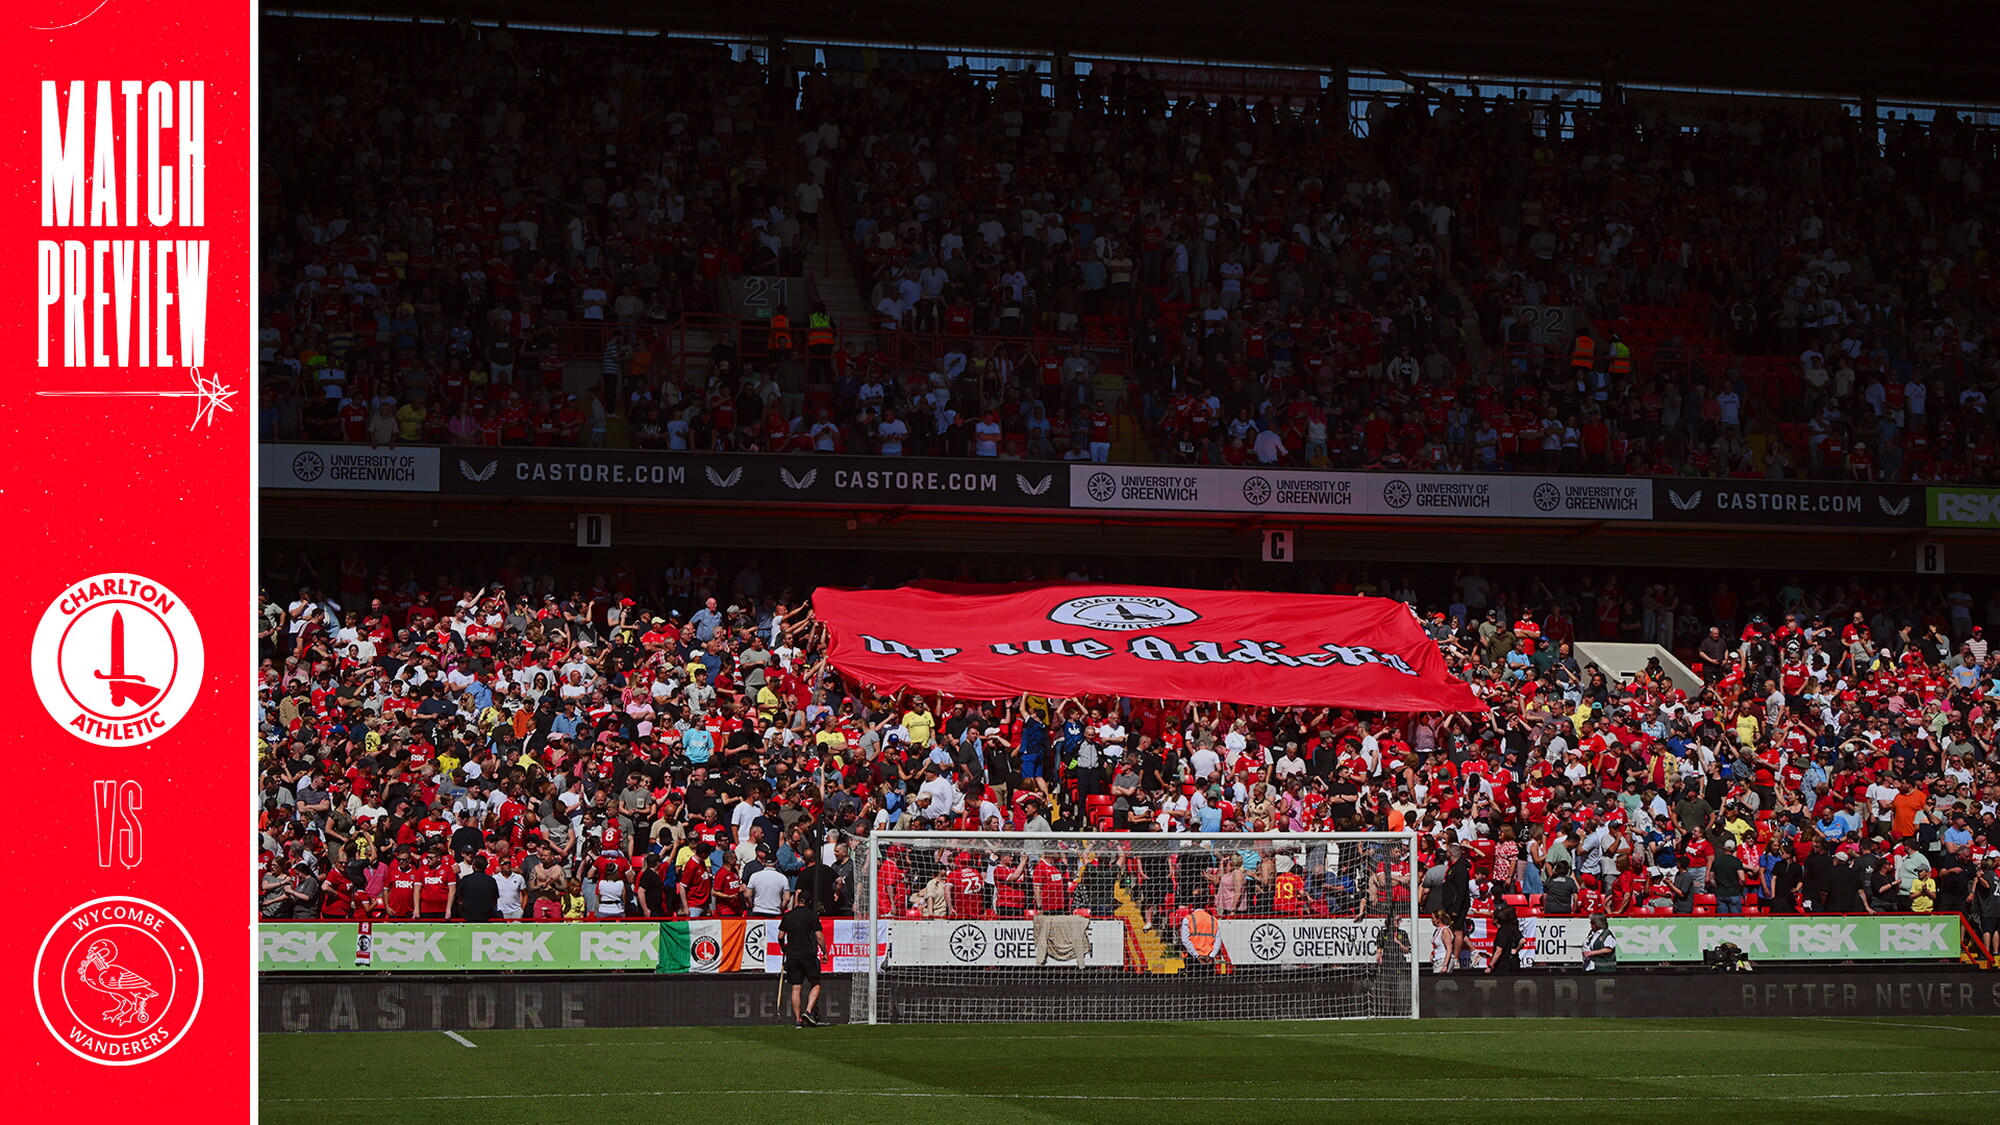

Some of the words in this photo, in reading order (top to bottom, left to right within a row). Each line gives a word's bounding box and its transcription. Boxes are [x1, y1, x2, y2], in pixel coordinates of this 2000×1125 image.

[743, 278, 787, 306] 21
[330, 455, 396, 467] UNIVERSITY
[400, 456, 415, 468] OF
[330, 467, 415, 482] GREENWICH
[516, 462, 686, 484] CASTORE.COM
[835, 470, 997, 492] CASTORE.COM
[1122, 476, 1180, 488] UNIVERSITY
[1183, 477, 1197, 488] OF
[1276, 480, 1331, 492] UNIVERSITY
[1335, 481, 1351, 493] OF
[1416, 483, 1470, 495] UNIVERSITY
[1474, 484, 1489, 495] OF
[1122, 487, 1198, 501] GREENWICH
[1276, 491, 1352, 505] GREENWICH
[1565, 486, 1618, 498] UNIVERSITY
[1622, 487, 1636, 498] OF
[1416, 494, 1490, 508] GREENWICH
[1565, 497, 1637, 511] GREENWICH
[1717, 492, 1861, 513] CASTORE.COM
[1938, 493, 2000, 522] RSK
[587, 516, 600, 545] D
[1270, 532, 1285, 559] C
[1924, 545, 1936, 571] B
[605, 831, 614, 842] 8
[396, 880, 414, 889] RSK
[425, 876, 443, 885] RSK
[961, 877, 982, 895] 23
[1275, 882, 1294, 899] 19
[1587, 899, 1595, 911] 2
[994, 928, 1034, 941] UNIVE
[1293, 926, 1368, 939] UNIVERSITY
[1550, 925, 1566, 938] OF
[1614, 925, 1678, 954] RSK
[1698, 925, 1769, 953] RSK
[1789, 924, 1859, 952] RSK
[1880, 923, 1949, 951] RSK
[258, 931, 338, 962] RSK
[371, 931, 446, 962] RSK
[471, 931, 554, 962] RSK
[580, 931, 659, 962] RSK
[1293, 941, 1377, 957] GREENWIC
[1742, 984, 1857, 1008] BETTER
[1876, 983, 1974, 1009] NEVER
[281, 983, 586, 1032] CASTORE
